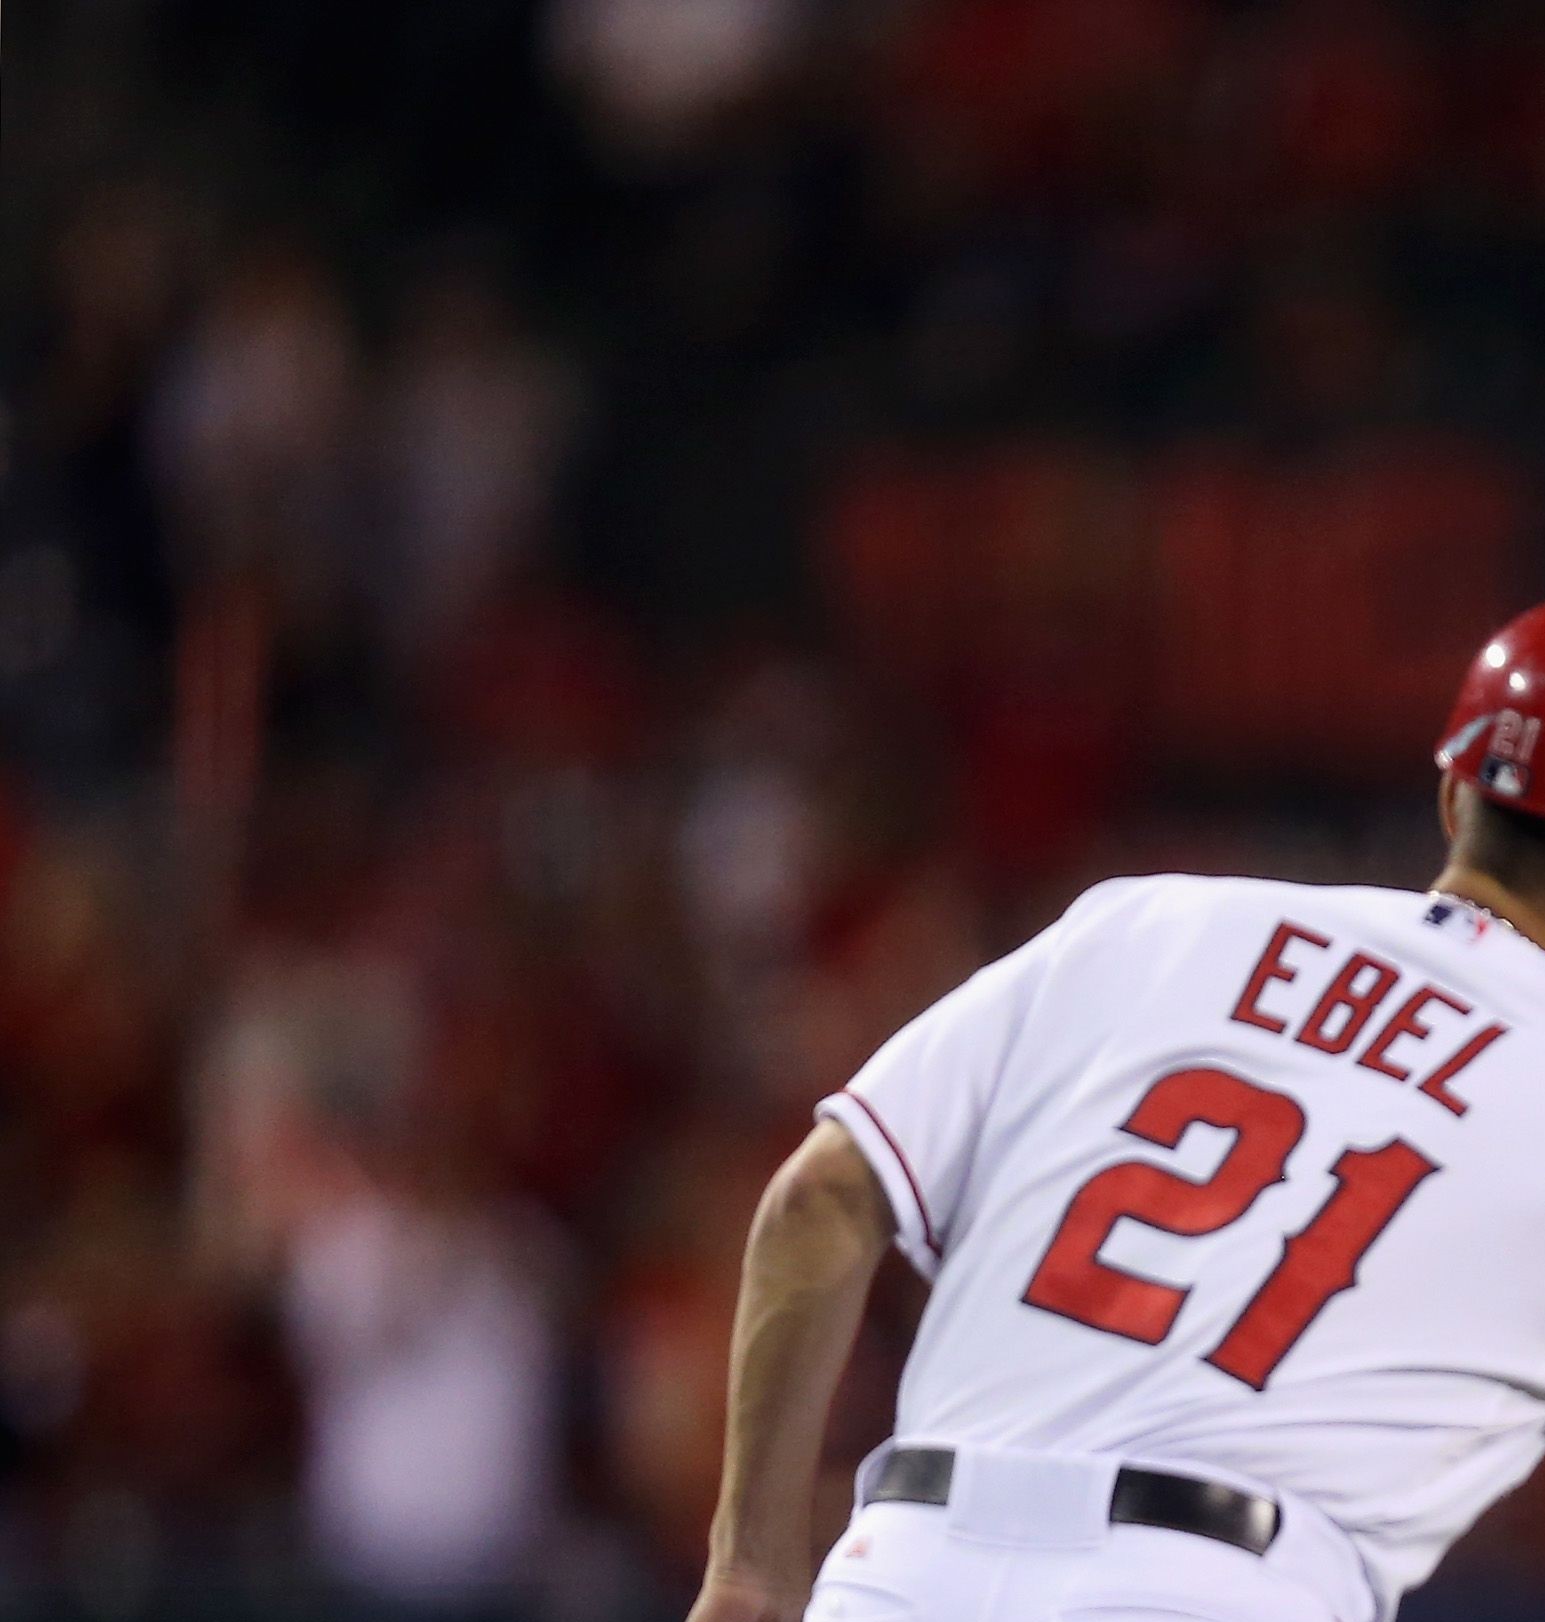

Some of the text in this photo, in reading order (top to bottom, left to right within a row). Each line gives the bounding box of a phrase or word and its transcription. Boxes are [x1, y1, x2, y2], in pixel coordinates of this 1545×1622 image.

[1489, 707, 1541, 761] 21
[1228, 918, 1509, 1119] EBEL
[1019, 1065, 1443, 1393] 21
